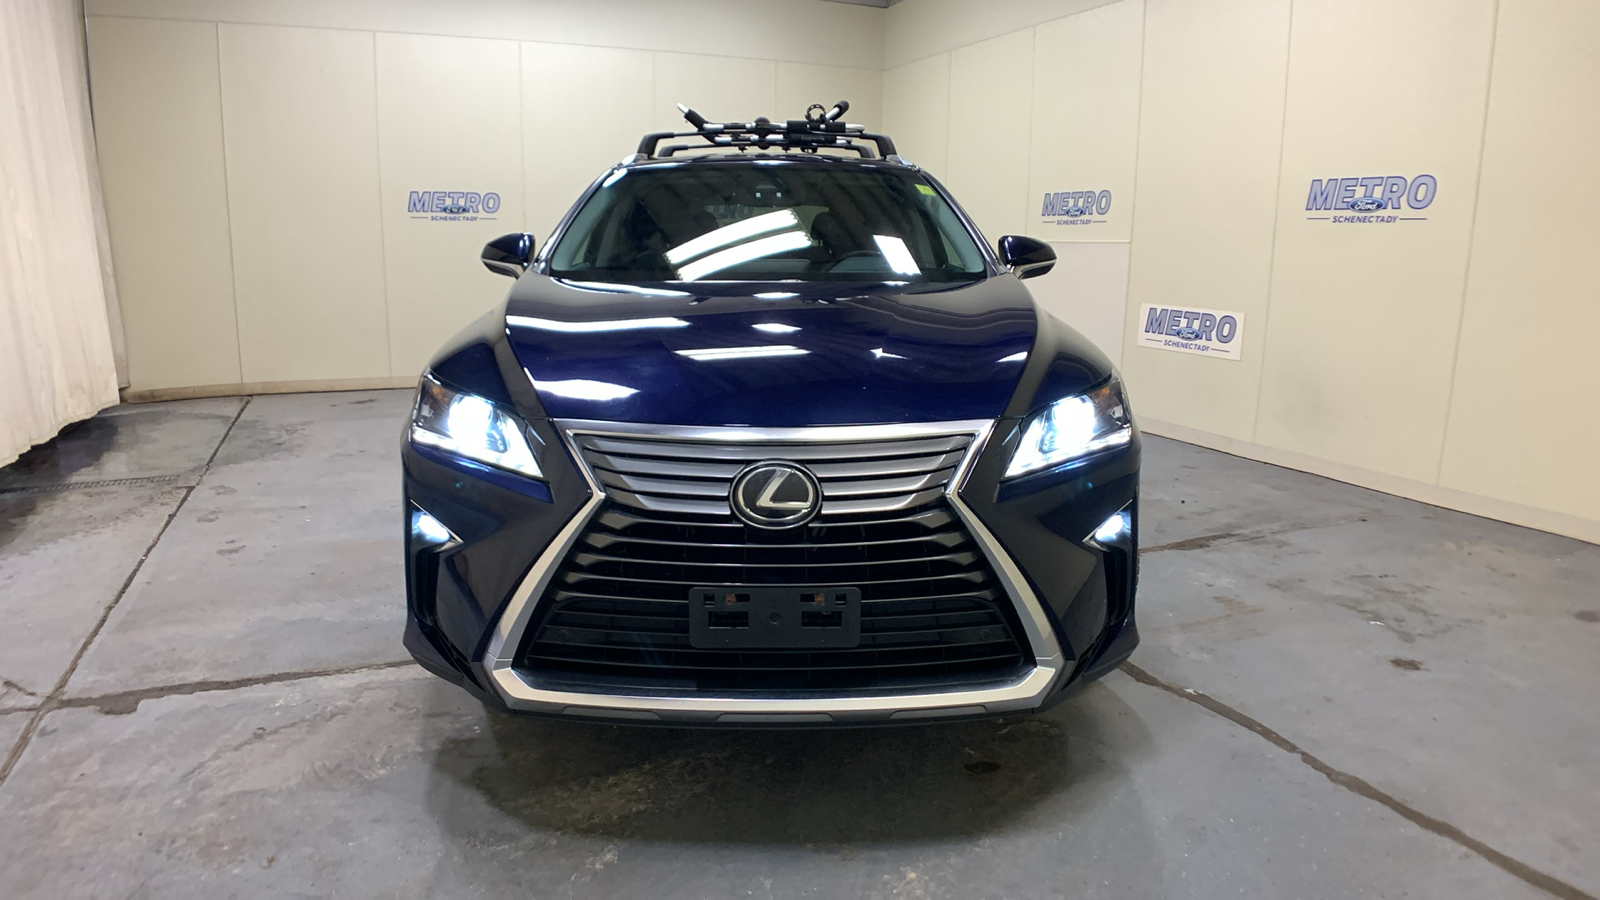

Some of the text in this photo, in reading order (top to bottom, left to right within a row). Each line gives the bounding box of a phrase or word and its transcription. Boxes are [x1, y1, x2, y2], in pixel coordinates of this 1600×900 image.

[407, 191, 501, 214] METRO
[1041, 189, 1112, 217] METRO
[1305, 174, 1438, 211] METRO
[1354, 199, 1379, 210] Ford
[1332, 215, 1399, 223] SCHENECTADY
[1144, 307, 1238, 344] METRO
[1163, 339, 1211, 352] SCHENECTADY
